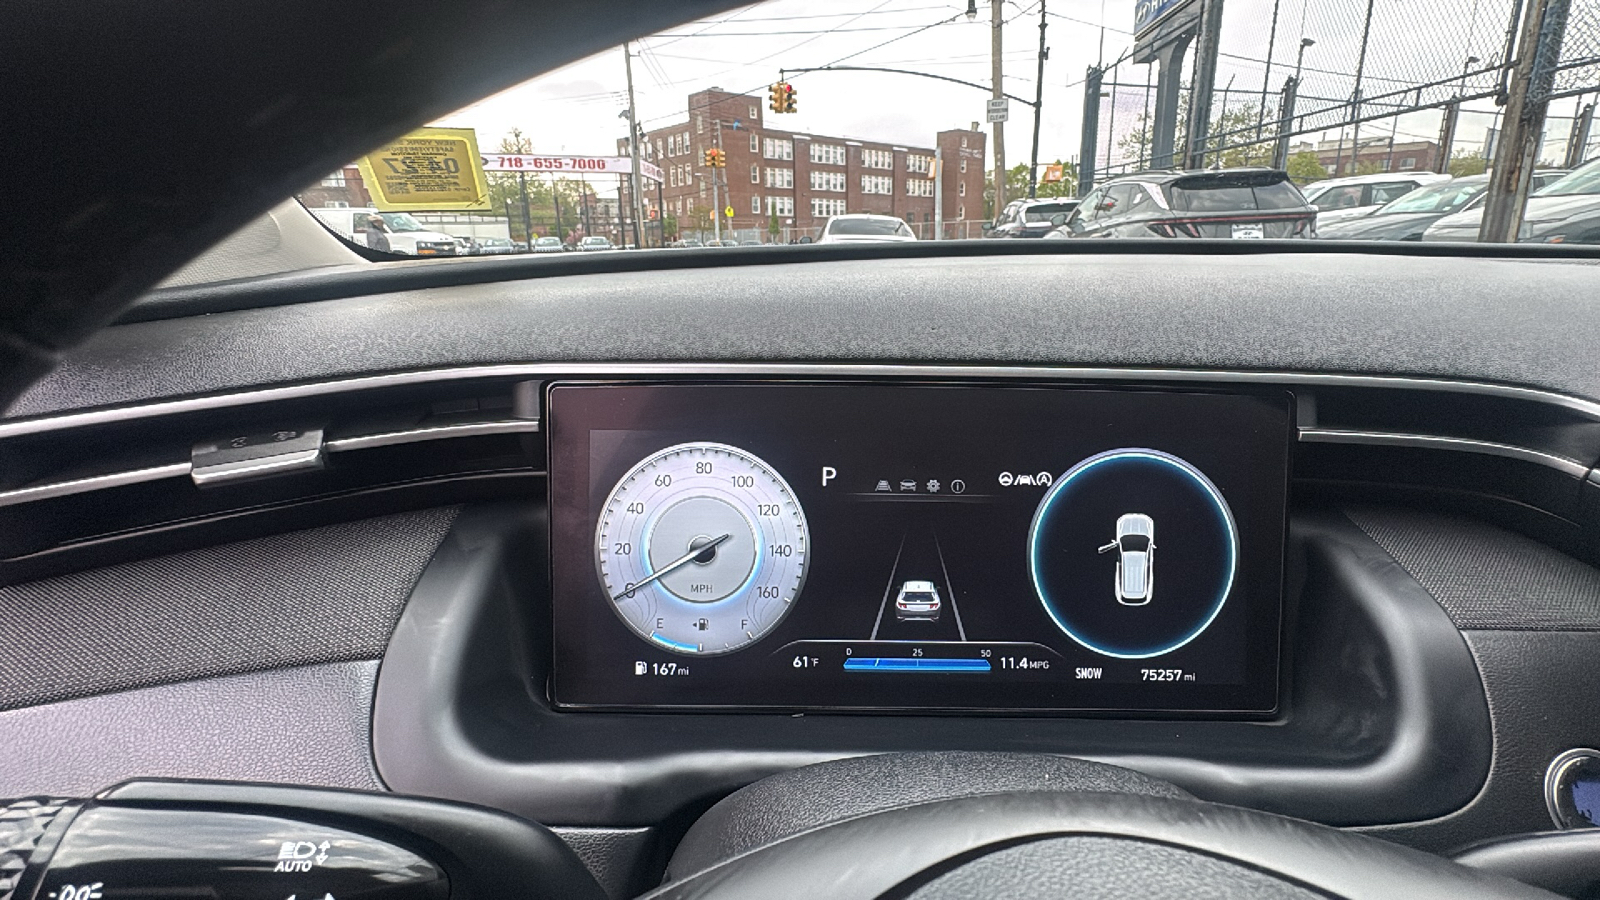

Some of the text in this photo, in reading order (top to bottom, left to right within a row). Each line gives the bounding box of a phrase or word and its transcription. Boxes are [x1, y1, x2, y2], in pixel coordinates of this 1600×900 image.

[696, 462, 713, 474] 80
[654, 475, 672, 487] 60
[731, 476, 754, 488] 100
[822, 466, 837, 487] P
[627, 502, 644, 514] 40
[758, 504, 780, 516] 120
[614, 543, 631, 555] 20
[769, 545, 792, 557] 140
[690, 584, 713, 593] MPH
[757, 586, 779, 598] 160
[656, 619, 664, 628] E
[741, 620, 748, 629] F
[912, 648, 923, 657] 25
[980, 649, 991, 657] 50
[793, 656, 808, 668] 61
[1075, 667, 1102, 679] SNOW
[1140, 669, 1182, 681] 75257
[274, 860, 312, 872] AUTO
